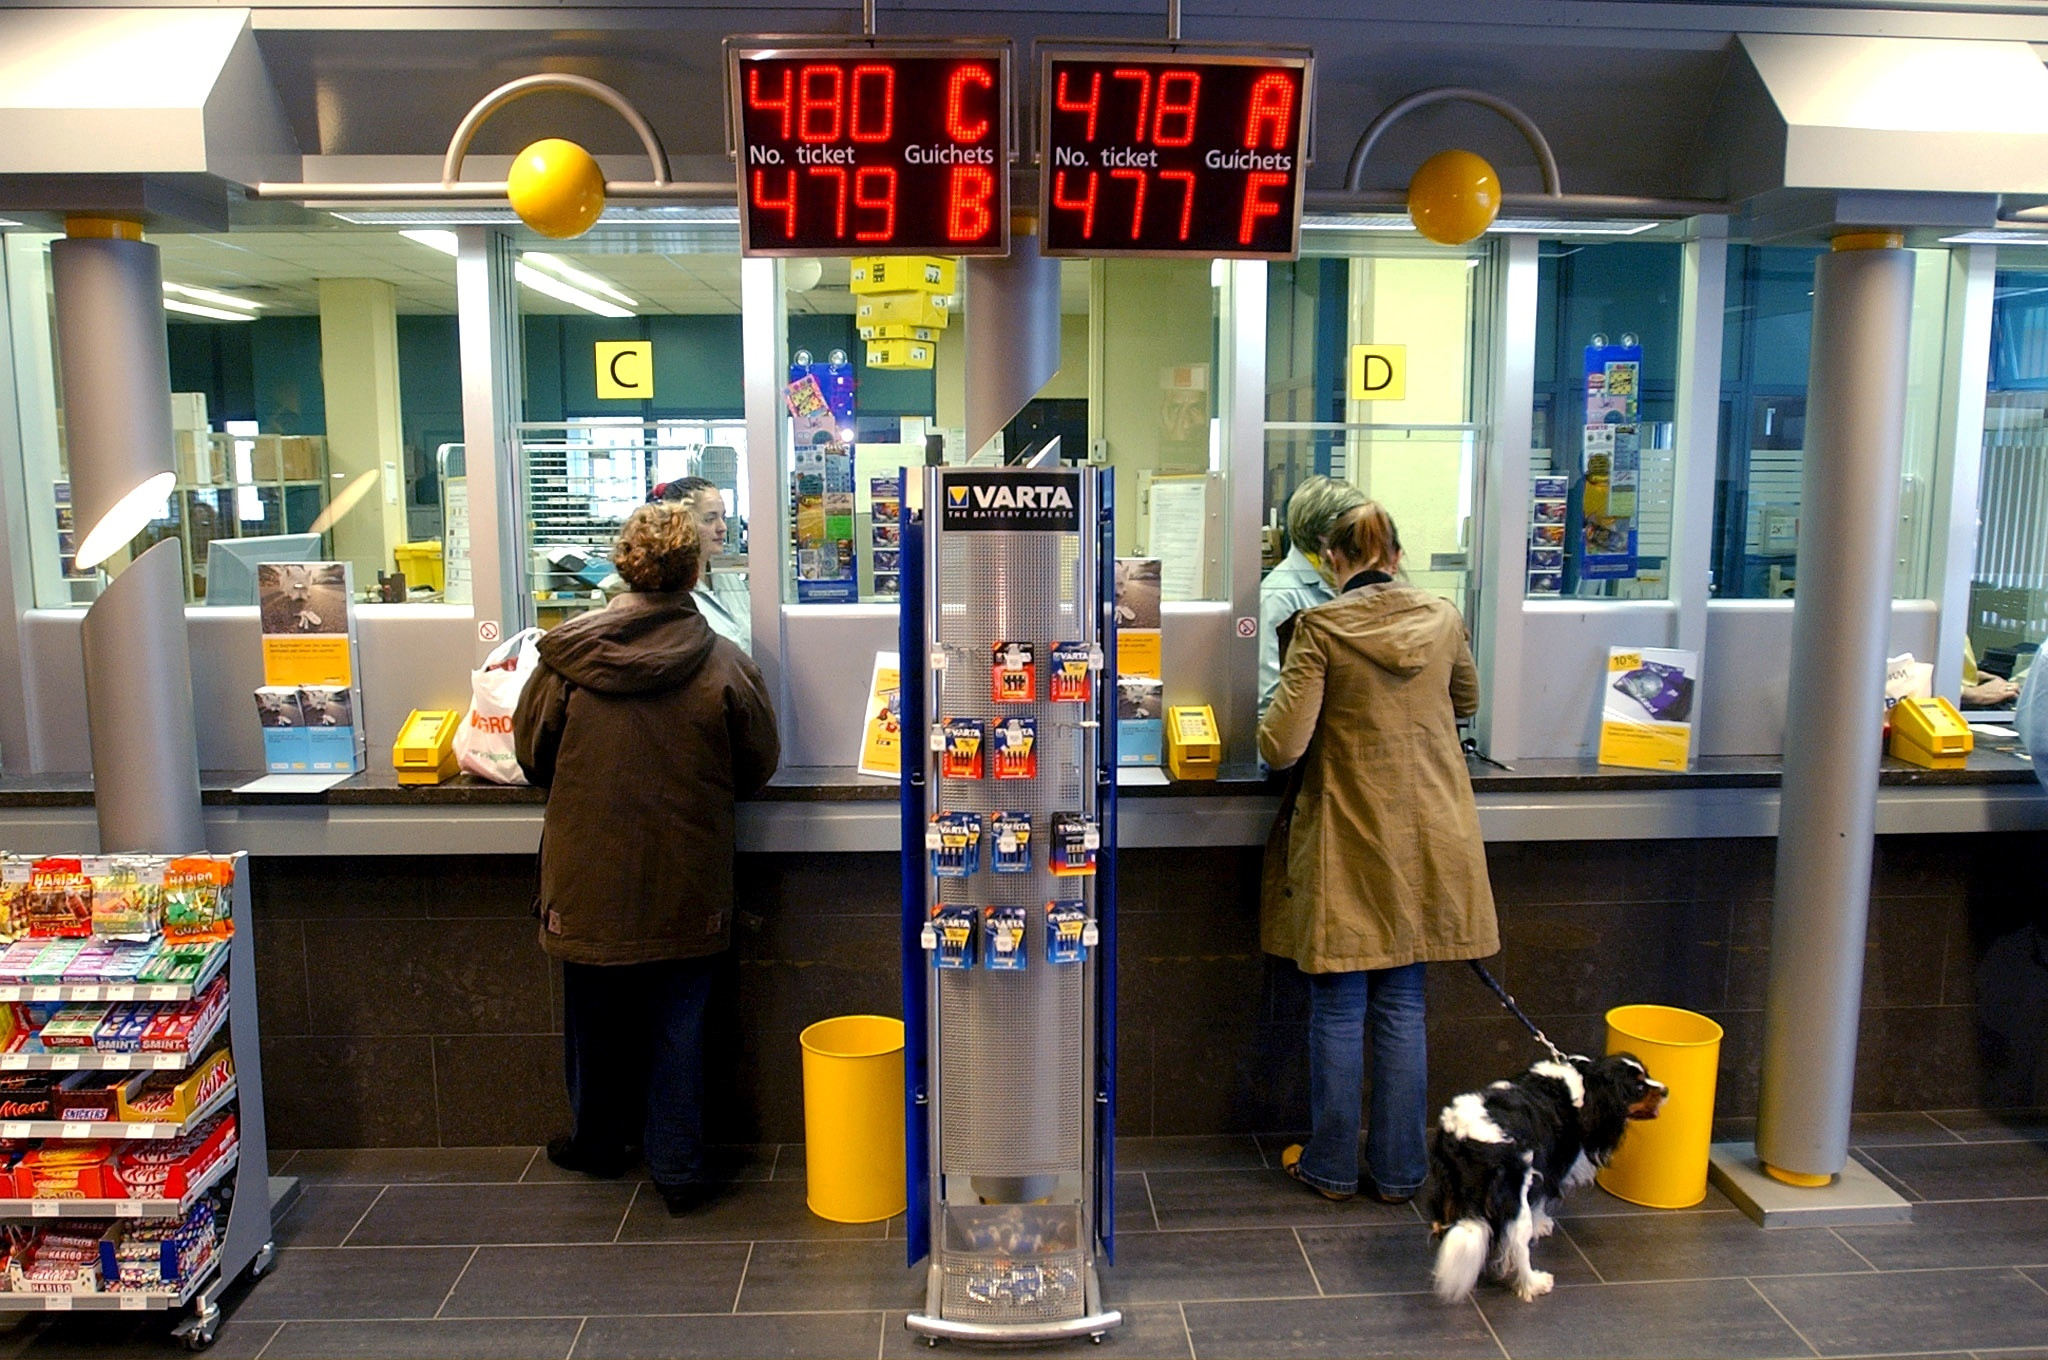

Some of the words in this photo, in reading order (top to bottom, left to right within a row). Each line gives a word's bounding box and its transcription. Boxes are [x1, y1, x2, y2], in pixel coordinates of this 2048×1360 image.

[749, 66, 894, 141] 480
[946, 66, 991, 142] C
[1057, 70, 1200, 145] 478
[1245, 74, 1294, 149] A
[750, 146, 785, 165] No.
[796, 146, 855, 165] ticket
[905, 145, 993, 164] Guichets
[1055, 147, 1089, 167] No.
[1101, 147, 1158, 168] ticket
[1205, 149, 1291, 171] Guichets
[753, 168, 897, 239] 479
[948, 168, 992, 240] B
[1054, 171, 1195, 240] 477
[1239, 173, 1289, 243] F
[610, 350, 638, 388] C
[1364, 355, 1393, 391] D
[973, 485, 1073, 508] VARTA
[1061, 652, 1089, 660] VARTA
[34, 873, 83, 887] HARIBO
[98, 1039, 137, 1050] SMINT
[142, 1039, 181, 1050] SMINT
[0, 1100, 49, 1117] Mars
[63, 1109, 106, 1120] SNICKERS
[48, 1250, 82, 1260] HARIBO
[31, 1284, 71, 1293] HARIBO
